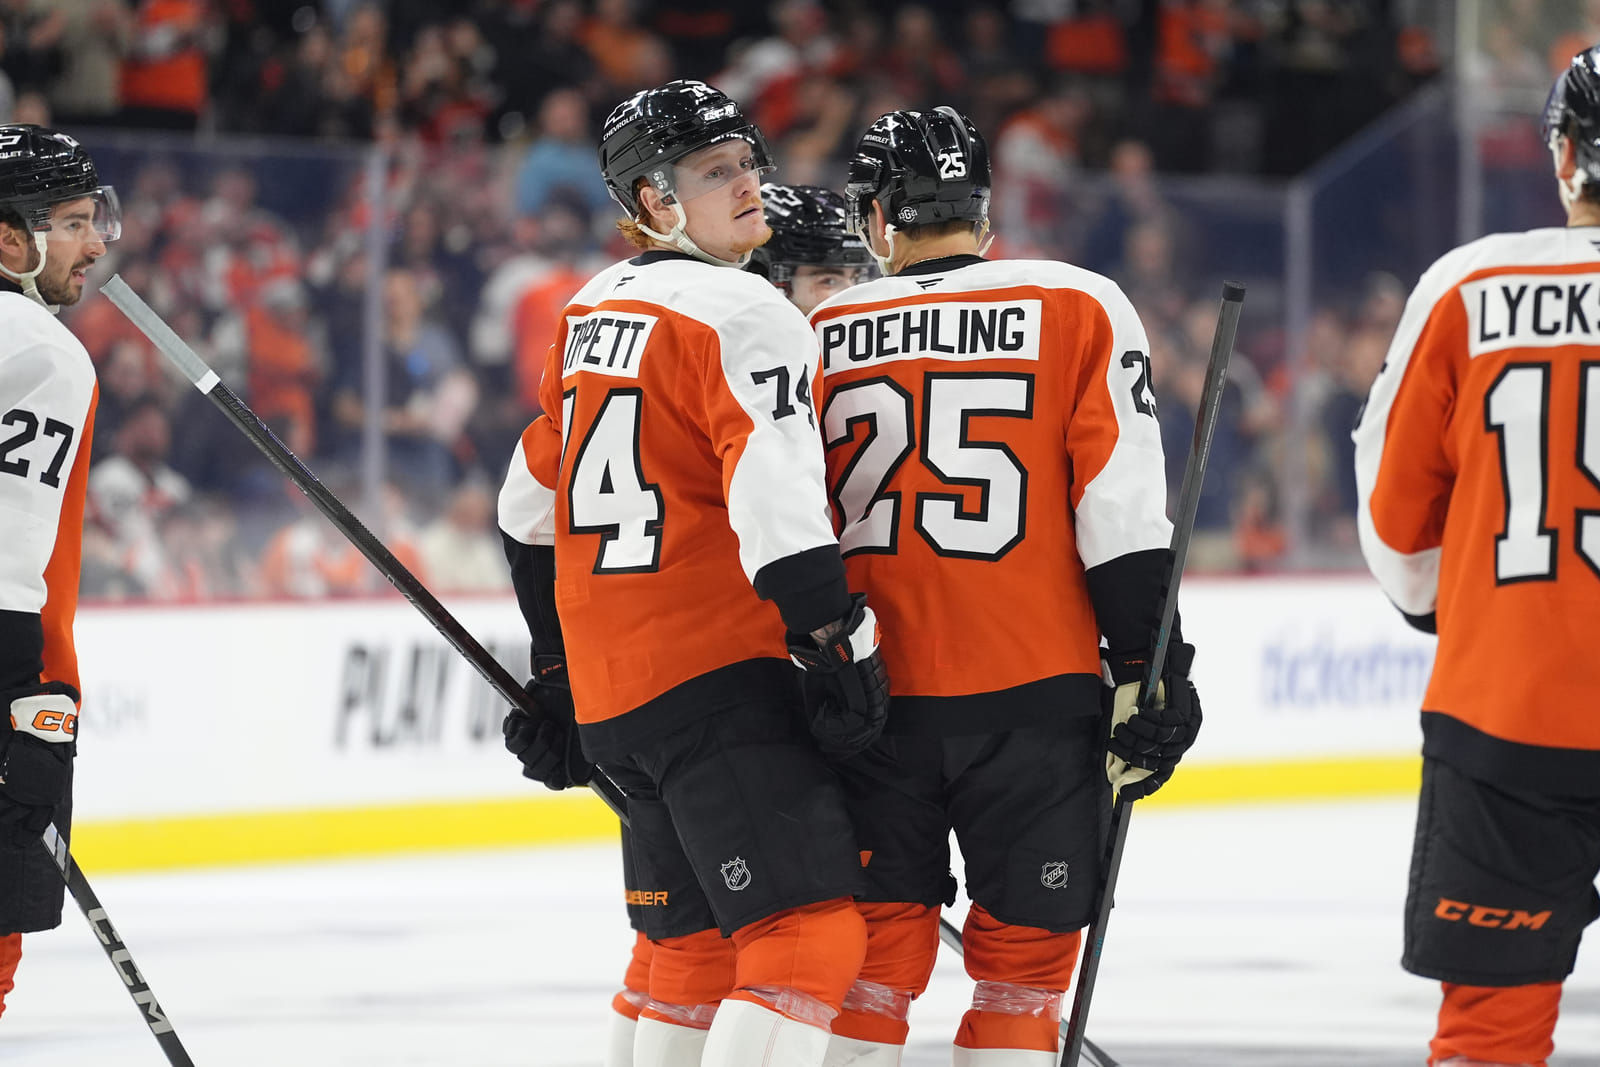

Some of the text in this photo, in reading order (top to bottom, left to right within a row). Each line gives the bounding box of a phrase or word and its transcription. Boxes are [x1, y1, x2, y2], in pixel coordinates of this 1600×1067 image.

[603, 114, 640, 141] CHEVROLET
[937, 152, 966, 179] 25
[823, 307, 1025, 369] POEHLING
[1480, 283, 1600, 342] LYCK
[0, 408, 74, 489] 27
[820, 370, 1035, 562] 25
[1484, 360, 1600, 588] 1
[1046, 865, 1064, 883] NHL
[1434, 897, 1552, 930] CCM
[87, 907, 175, 1035] CCM
